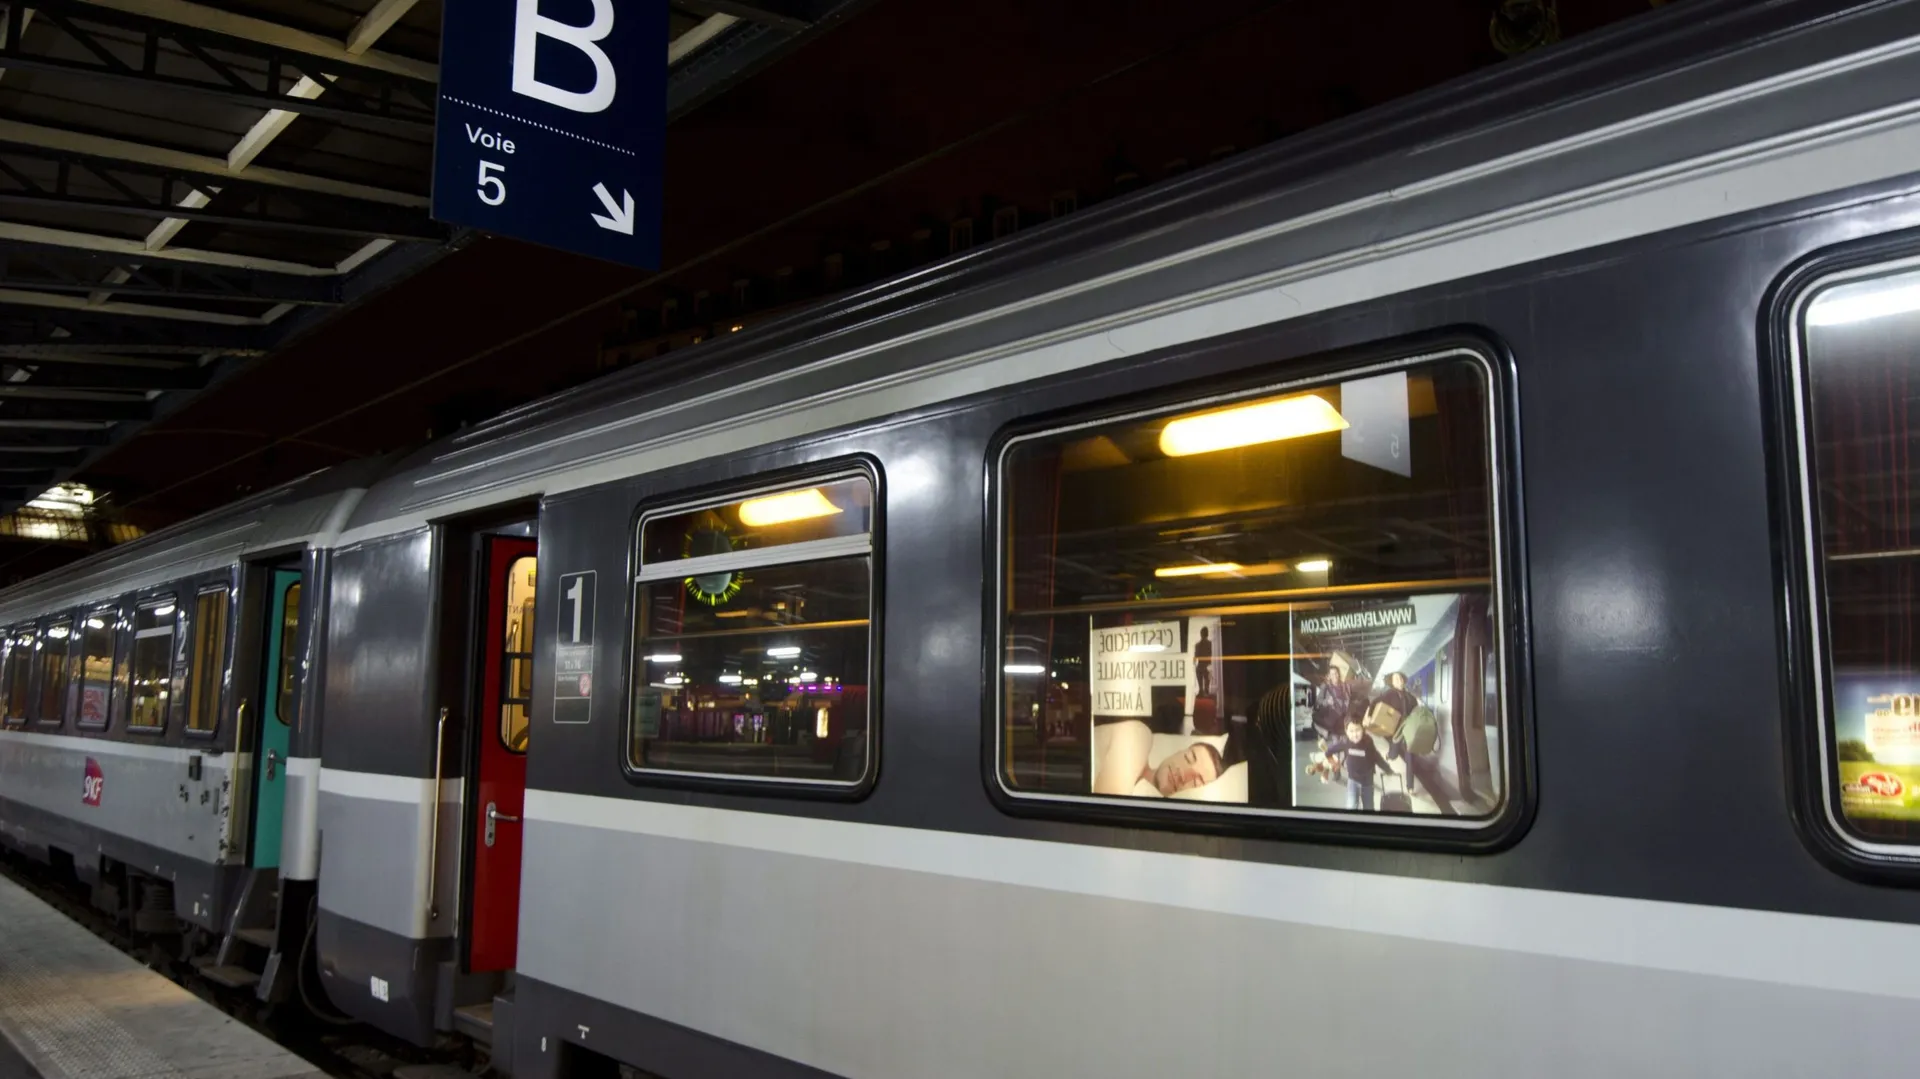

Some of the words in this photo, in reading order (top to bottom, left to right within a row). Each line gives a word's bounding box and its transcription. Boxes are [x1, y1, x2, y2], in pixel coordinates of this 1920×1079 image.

[512, 0, 617, 113] B
[465, 123, 516, 154] Voie
[477, 159, 506, 206] 5
[567, 576, 583, 643] 1
